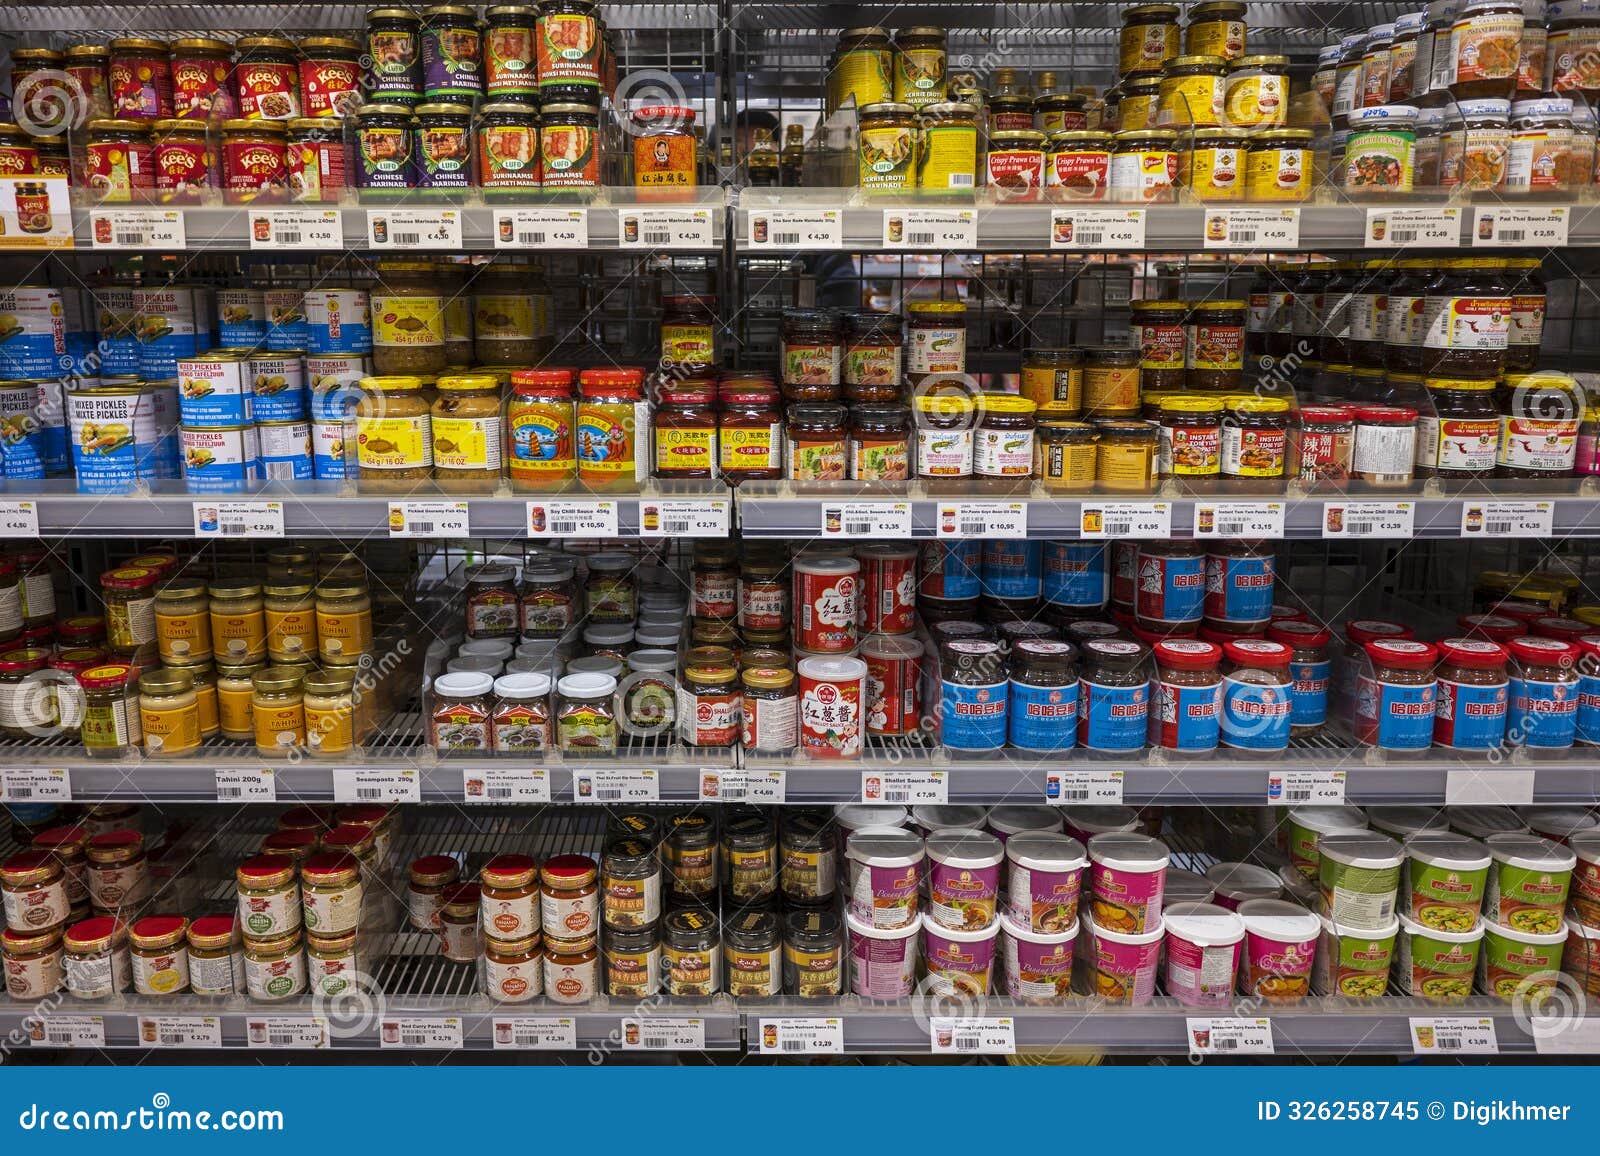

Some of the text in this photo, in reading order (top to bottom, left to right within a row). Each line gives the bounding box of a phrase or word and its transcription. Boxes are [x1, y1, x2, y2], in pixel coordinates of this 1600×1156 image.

[175, 69, 208, 86] Kee's
[245, 71, 281, 87] Kee's
[317, 69, 354, 85] Kee's
[160, 152, 196, 170] Kee's
[240, 152, 279, 170] Kee's
[990, 155, 1028, 165] Crispy Prawn
[1057, 155, 1094, 165] Crispy Prawn
[194, 363, 222, 371] PICKLES
[1, 392, 29, 402] PICKLES
[2, 403, 30, 412] PICKLES
[75, 400, 127, 410] MIXED PICKLES
[76, 410, 128, 420] MIXTE PICKLES
[195, 433, 223, 441] PICKLES
[1319, 434, 1333, 458] 潮州
[1301, 436, 1319, 482] 辣椒油
[271, 719, 301, 727] TAHINI
